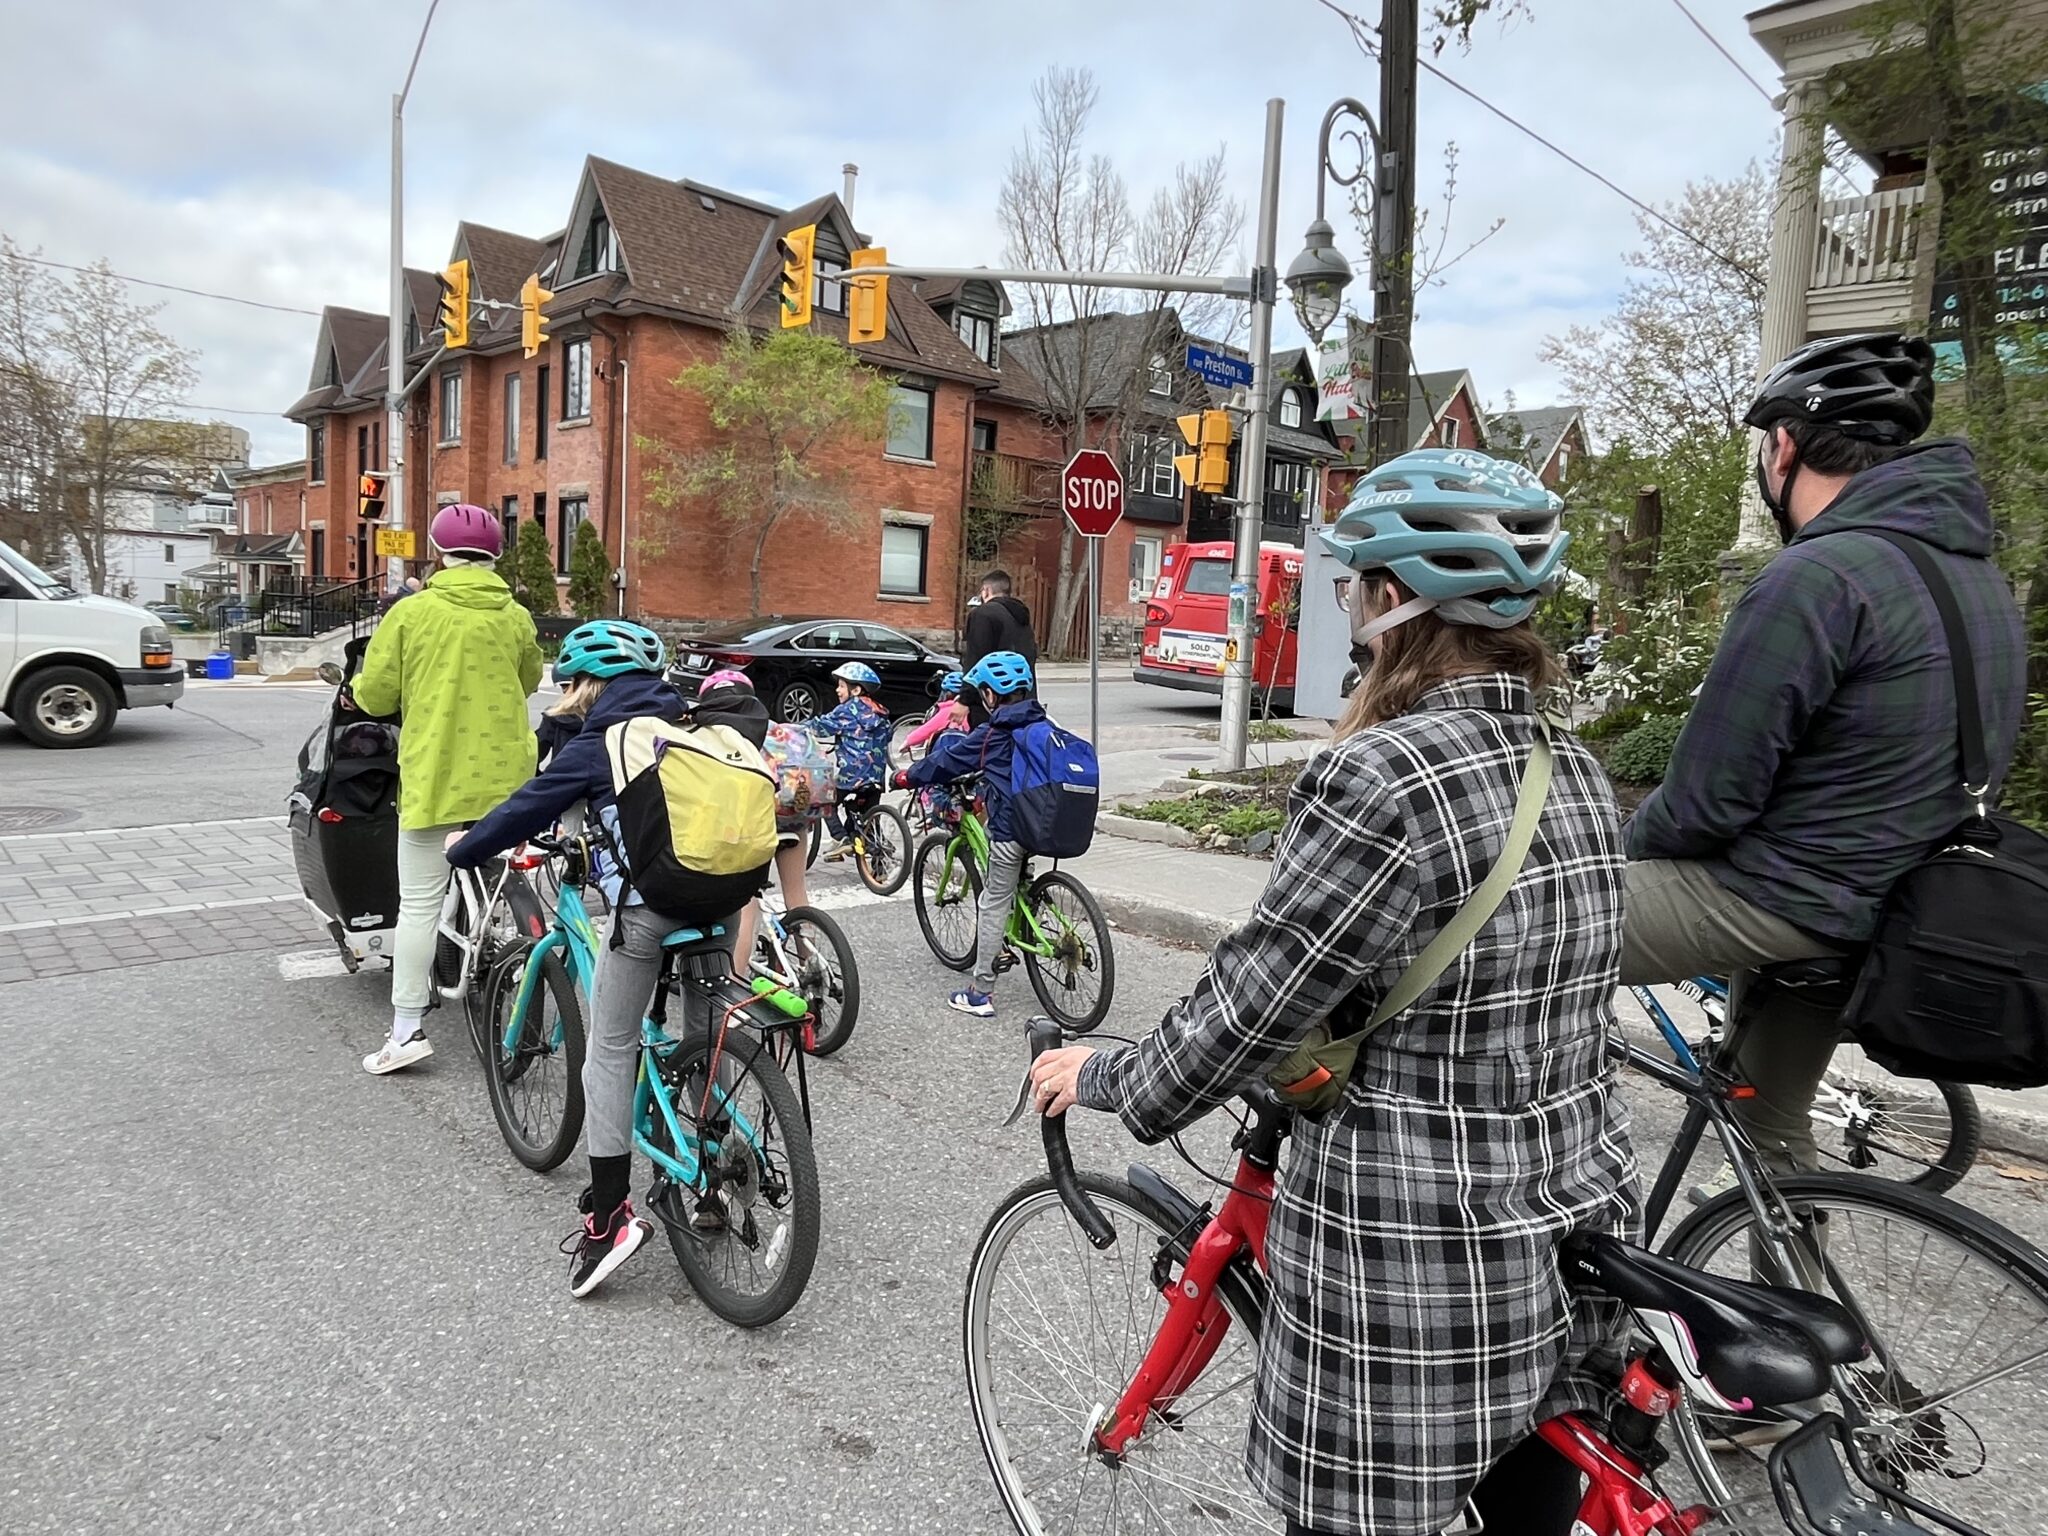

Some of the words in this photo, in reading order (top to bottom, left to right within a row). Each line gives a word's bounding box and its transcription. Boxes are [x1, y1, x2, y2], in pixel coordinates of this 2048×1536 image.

[1204, 355, 1236, 378] Preston
[1323, 361, 1349, 381] Littl
[1068, 476, 1119, 510] STOP
[1363, 492, 1413, 506] GIRO
[1190, 643, 1210, 652] SOLD
